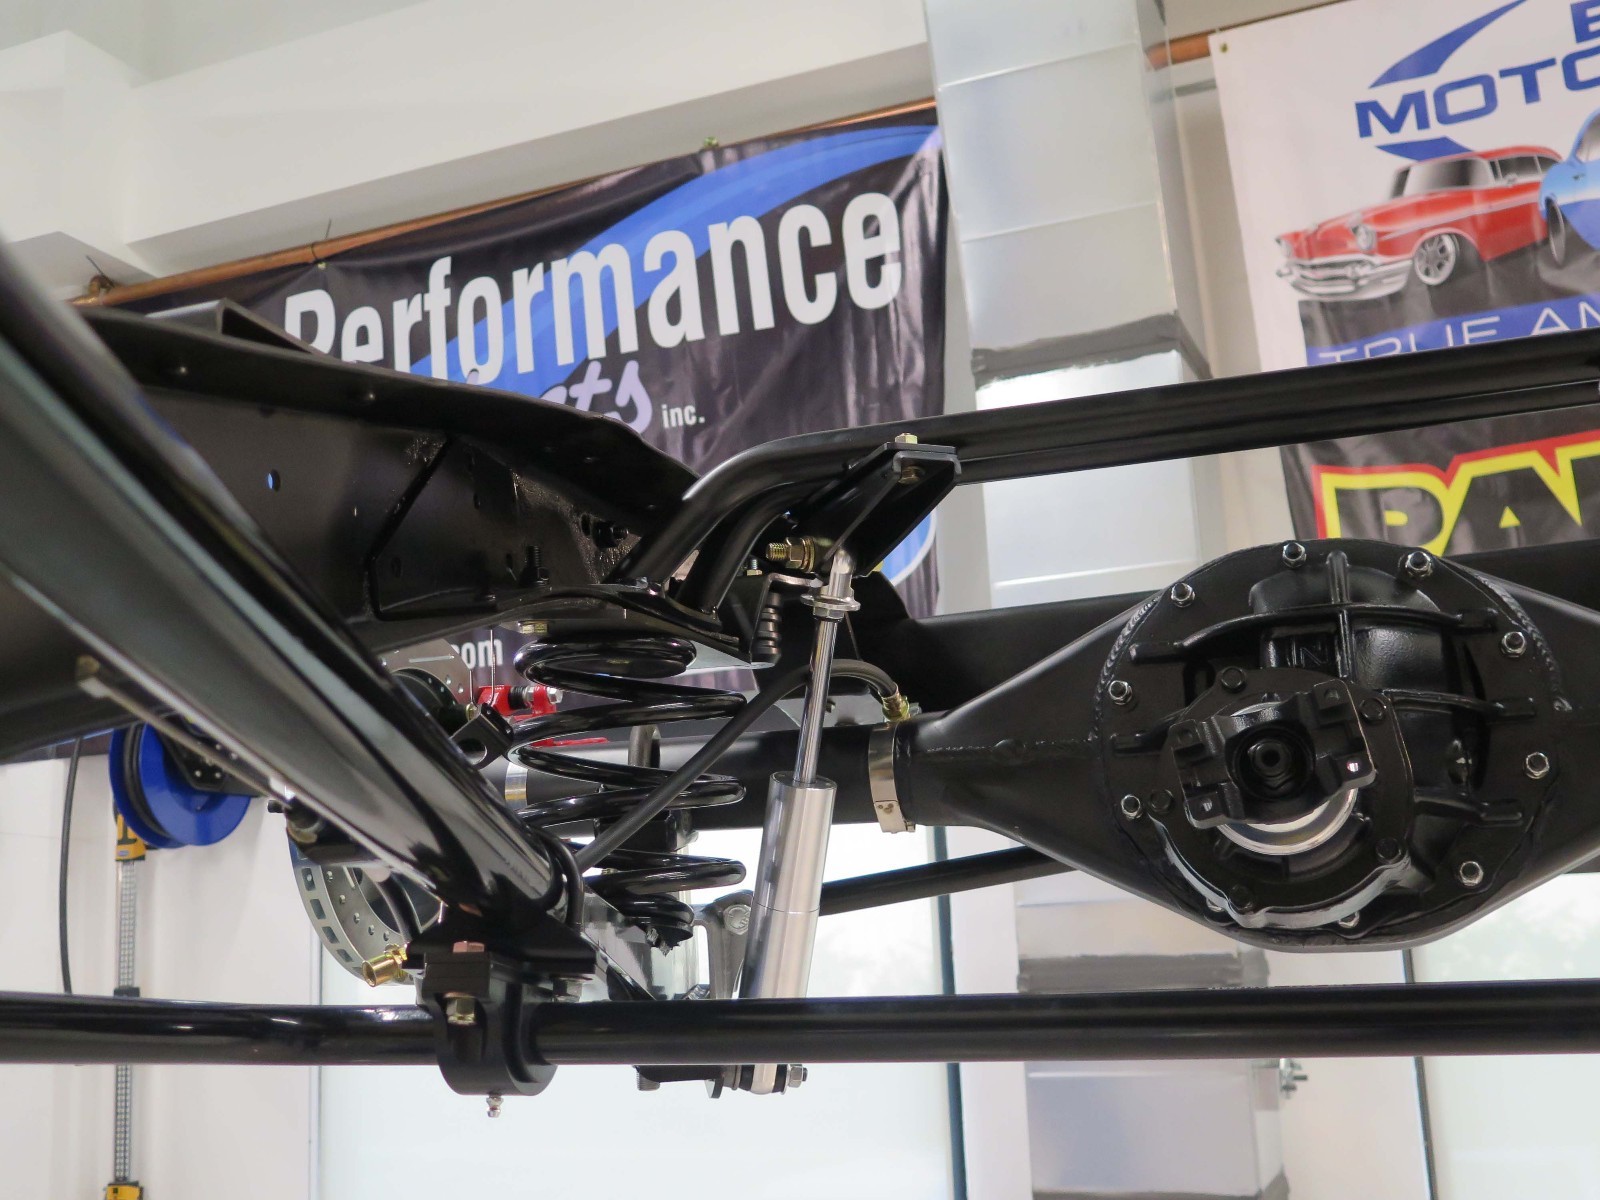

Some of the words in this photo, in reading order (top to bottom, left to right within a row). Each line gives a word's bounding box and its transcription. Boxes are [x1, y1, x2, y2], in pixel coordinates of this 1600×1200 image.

[284, 191, 902, 384] Performance
[661, 403, 705, 428] inc.
[451, 638, 504, 670] om
